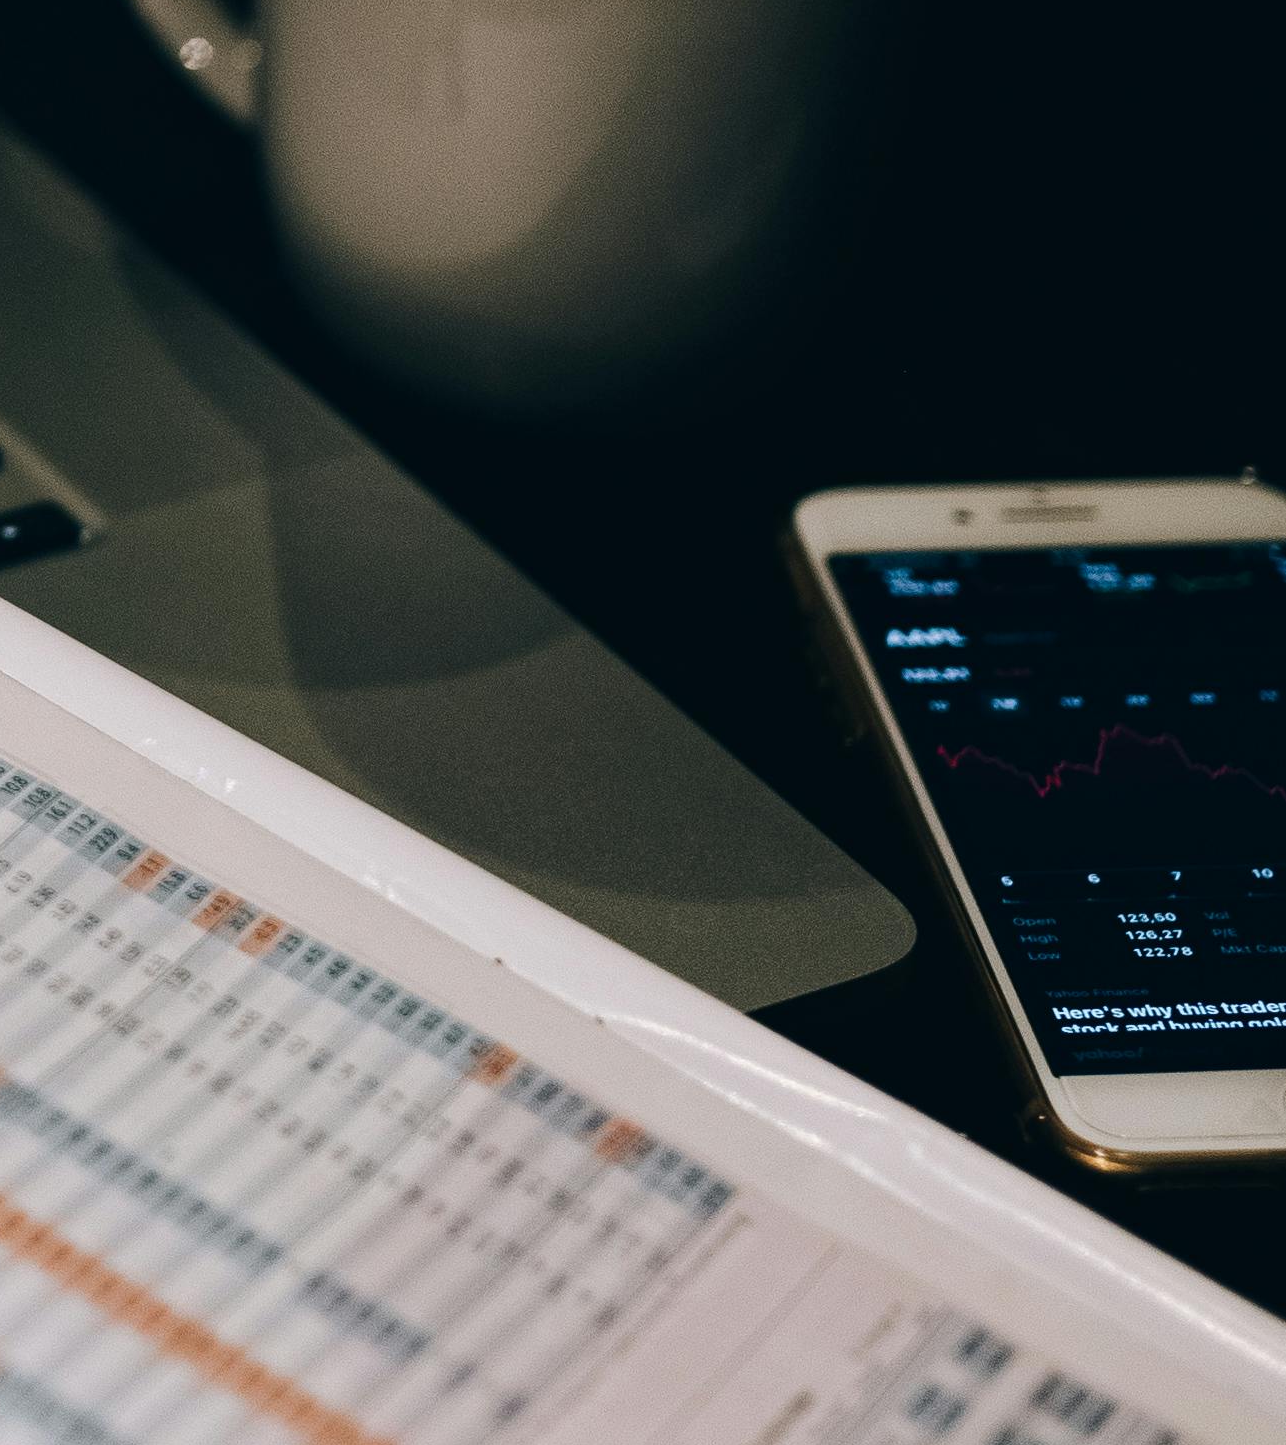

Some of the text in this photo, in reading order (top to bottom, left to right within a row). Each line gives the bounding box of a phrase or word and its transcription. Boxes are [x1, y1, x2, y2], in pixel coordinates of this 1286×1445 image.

[1001, 868, 1274, 887] 6 6 7 10
[1052, 1005, 1125, 1020] Here's
[1127, 1005, 1173, 1019] why
[1175, 1002, 1219, 1016] this
